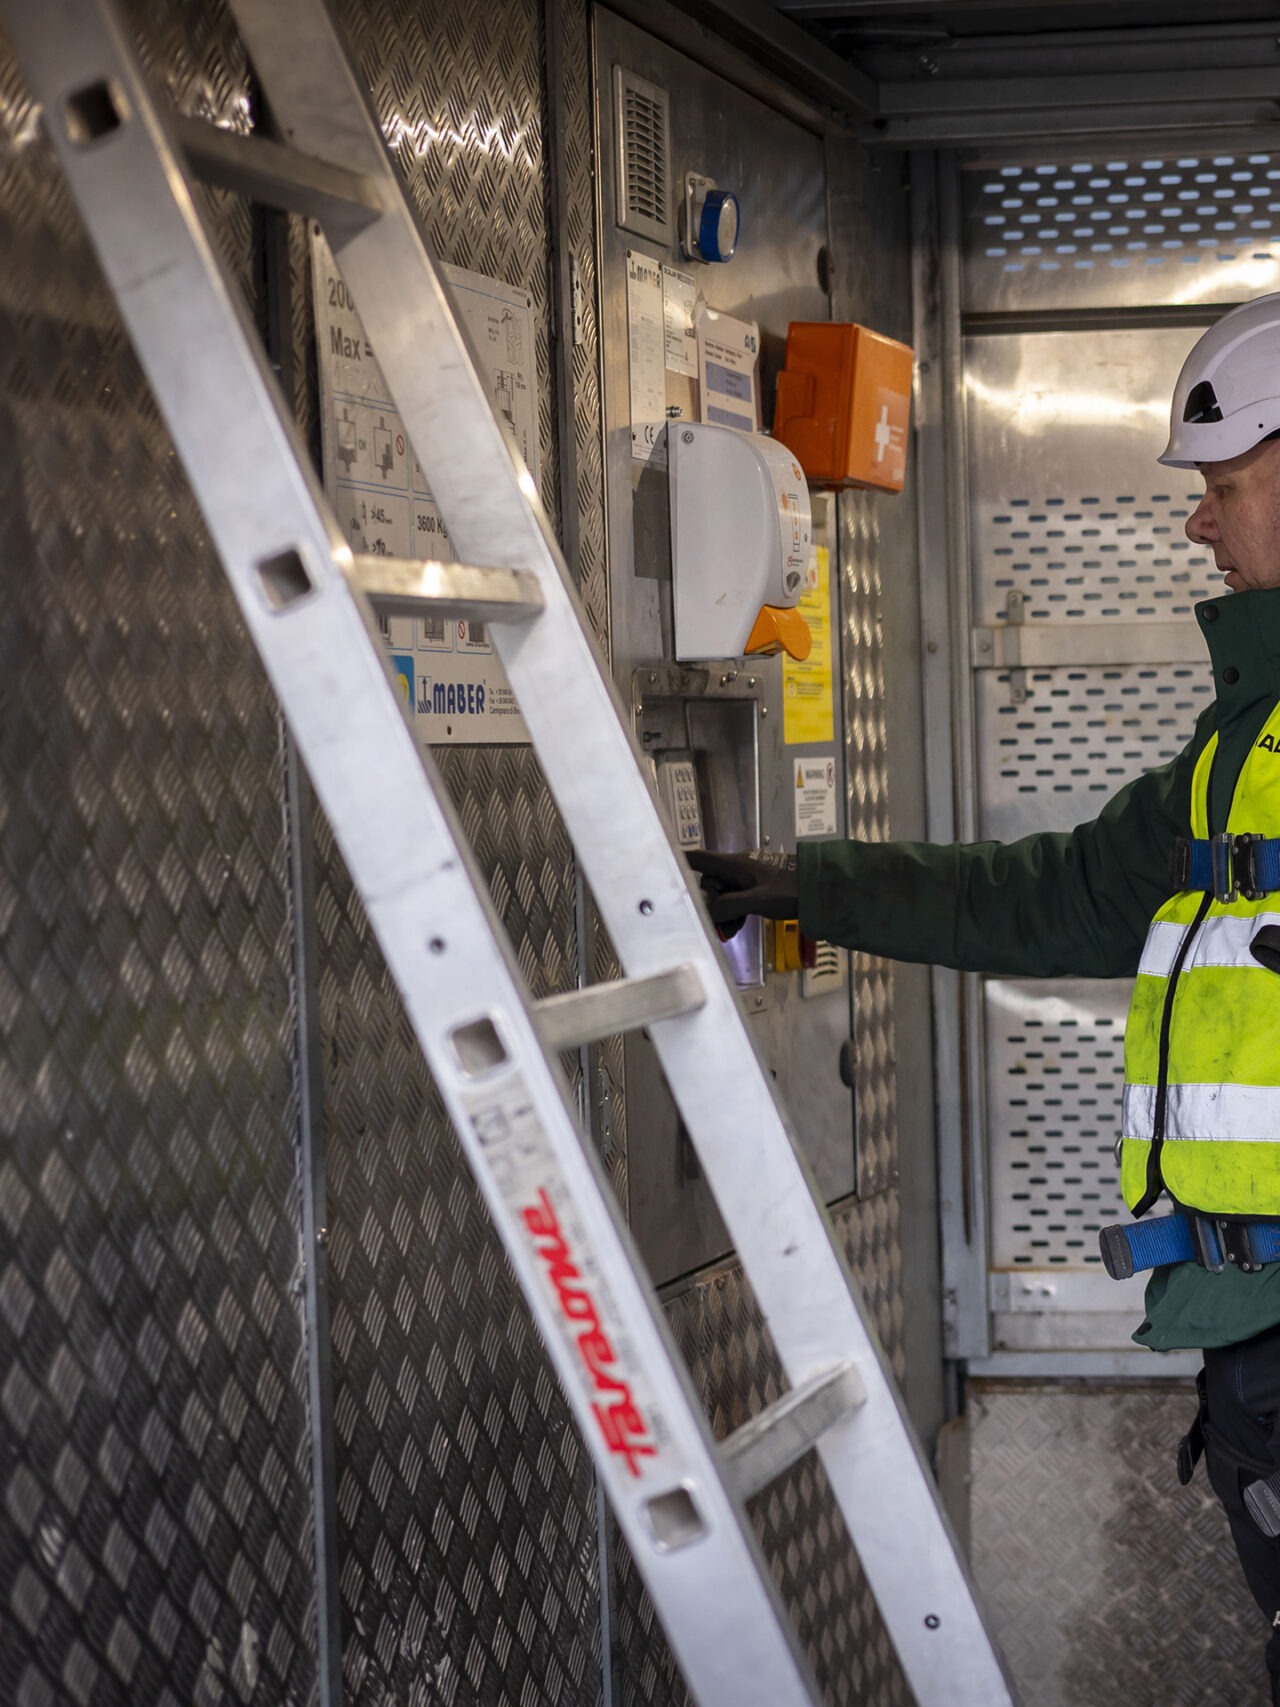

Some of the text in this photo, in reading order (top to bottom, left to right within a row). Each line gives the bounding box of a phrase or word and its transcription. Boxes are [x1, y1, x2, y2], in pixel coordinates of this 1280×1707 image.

[330, 326, 361, 361] Max
[417, 514, 435, 533] 3600
[433, 682, 485, 715] MABER
